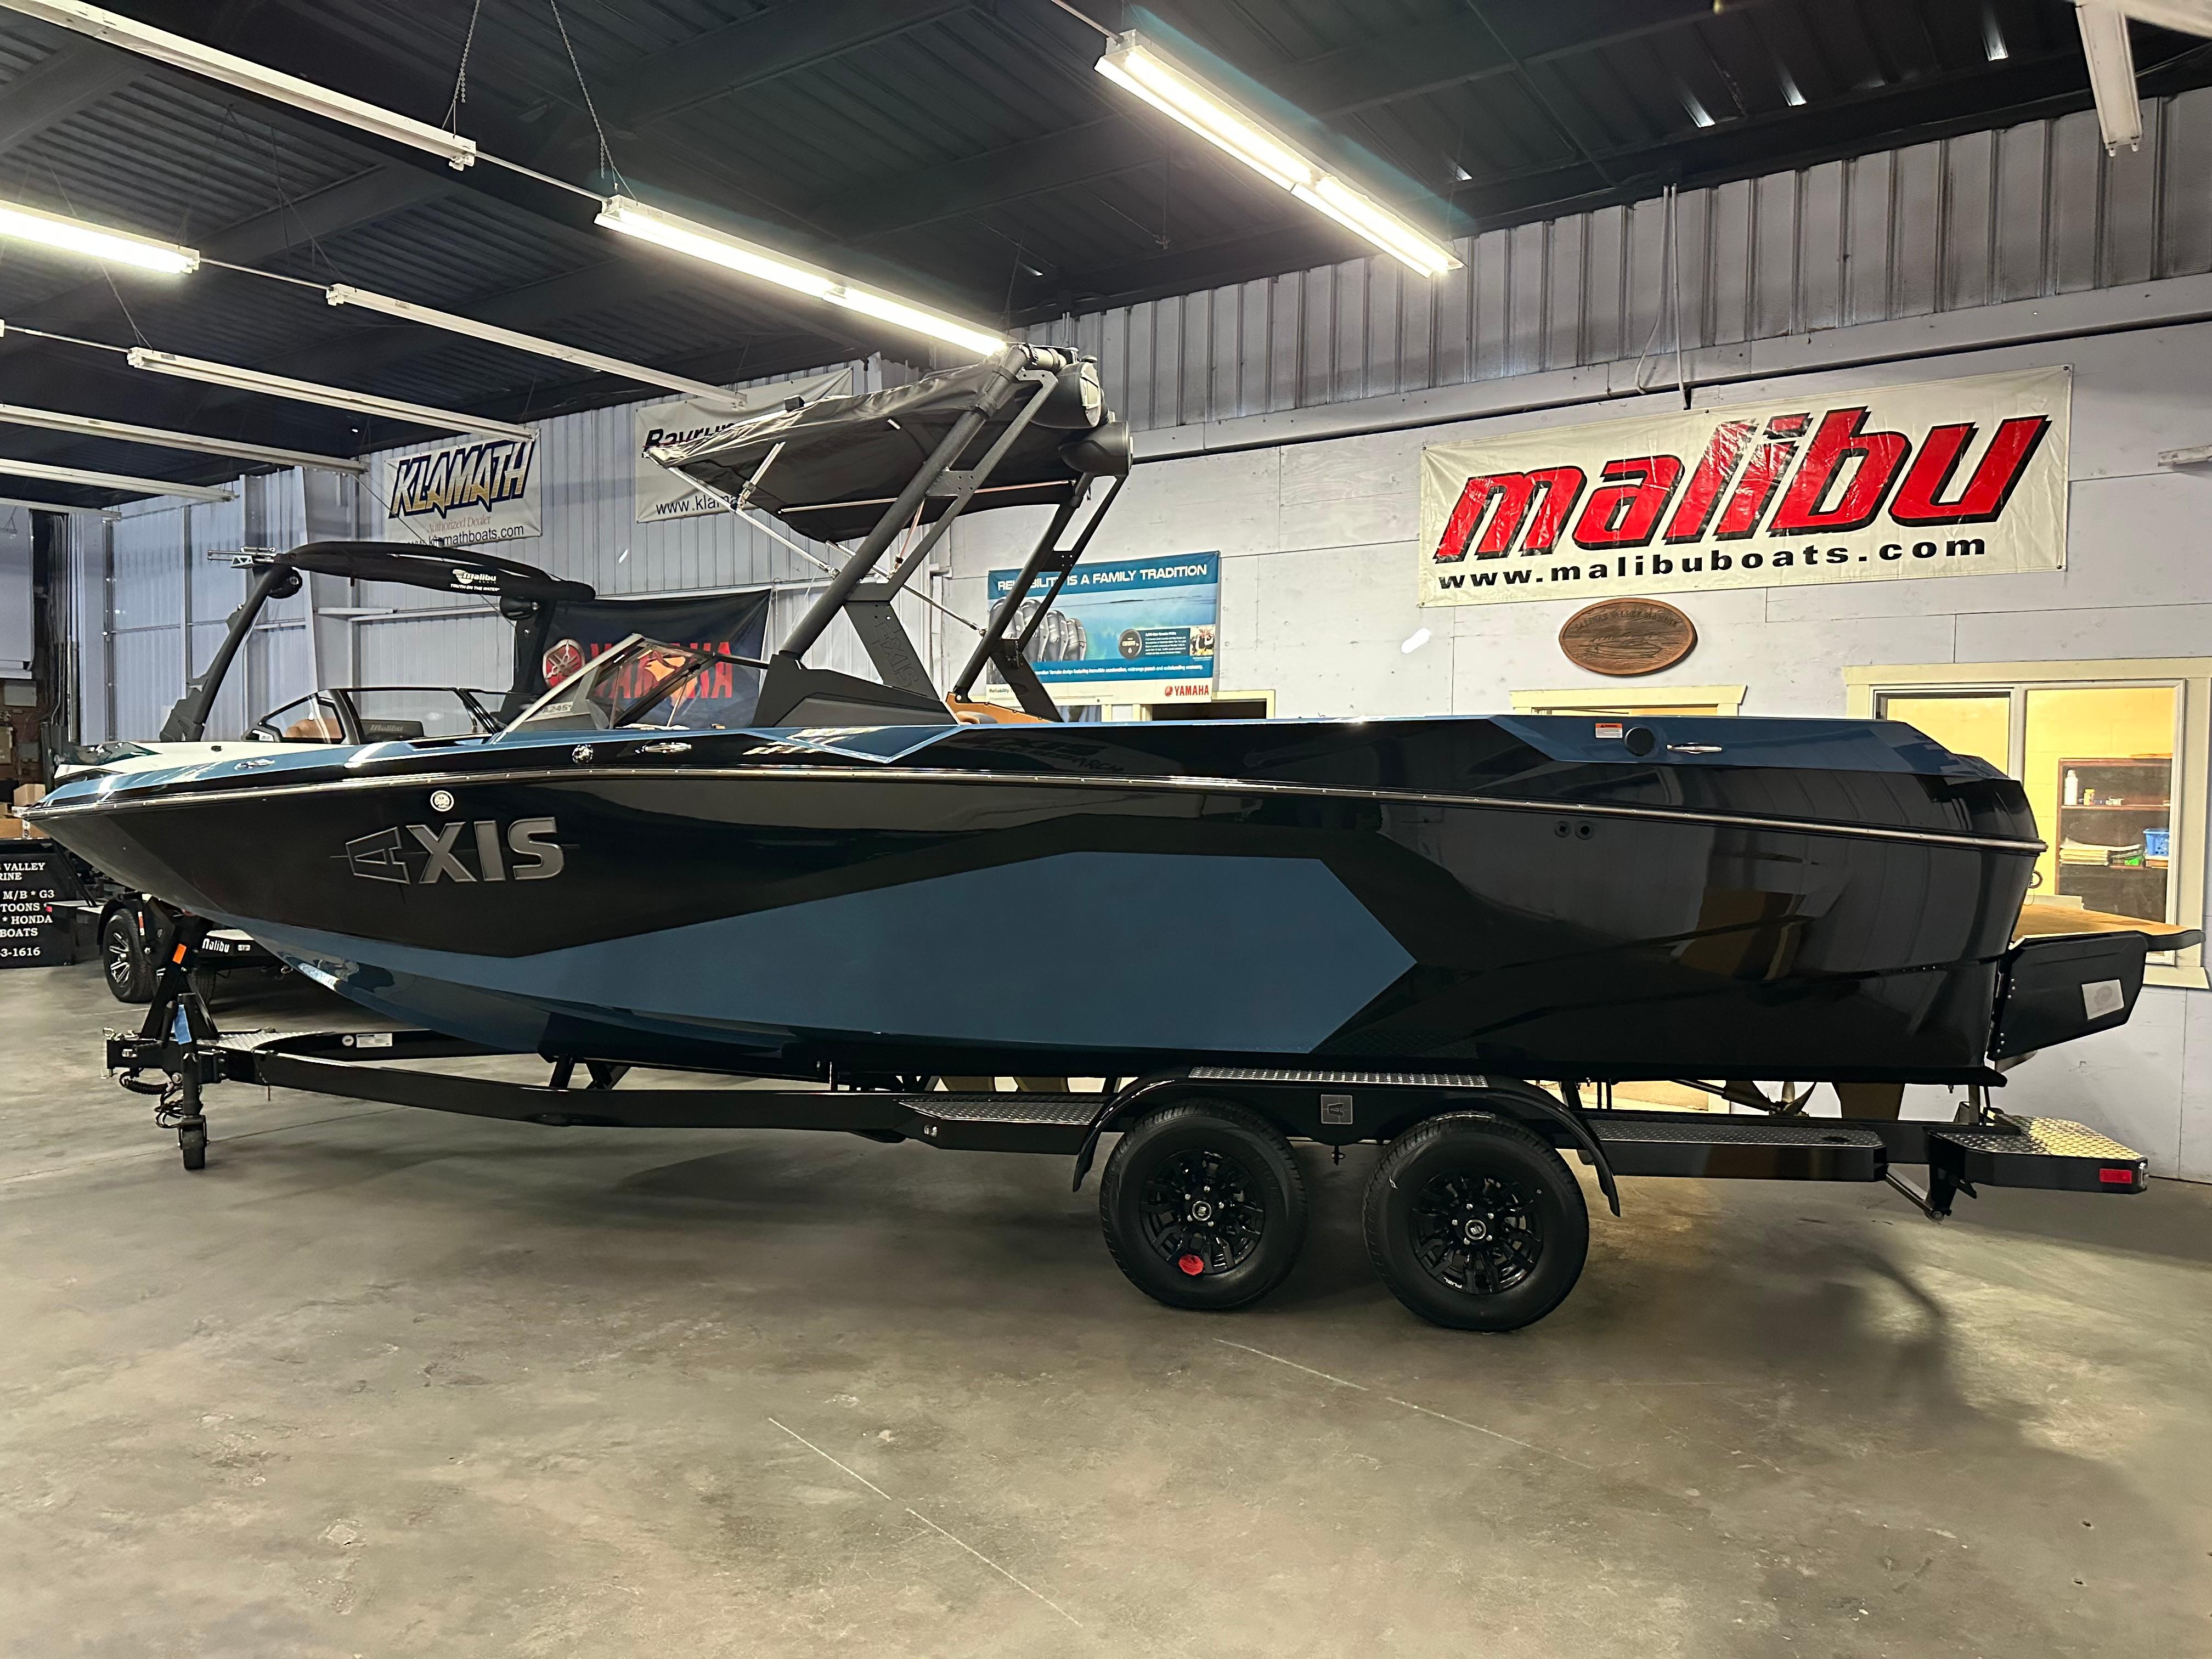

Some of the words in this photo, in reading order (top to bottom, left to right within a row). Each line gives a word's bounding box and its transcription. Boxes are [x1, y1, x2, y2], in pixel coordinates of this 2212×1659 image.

[388, 439, 535, 518] KLAMATH
[1434, 407, 2054, 563] malibu
[467, 515, 492, 527] Dealer
[1438, 538, 1985, 589] www.malibuboats.com
[1067, 575, 1077, 585] IS
[1080, 574, 1090, 585] A
[1093, 570, 1137, 584] FAMILY
[1139, 564, 1207, 580] TRADITION
[590, 642, 732, 699] YAMHA
[1175, 685, 1209, 696] YAMAHA
[346, 817, 565, 884] AXIS
[4, 862, 46, 871] VALLEY
[3, 890, 27, 900] M/B
[39, 890, 55, 899] G3
[2, 902, 40, 912] TOONS
[11, 915, 53, 925] HONDA
[0, 928, 38, 938] BOATS
